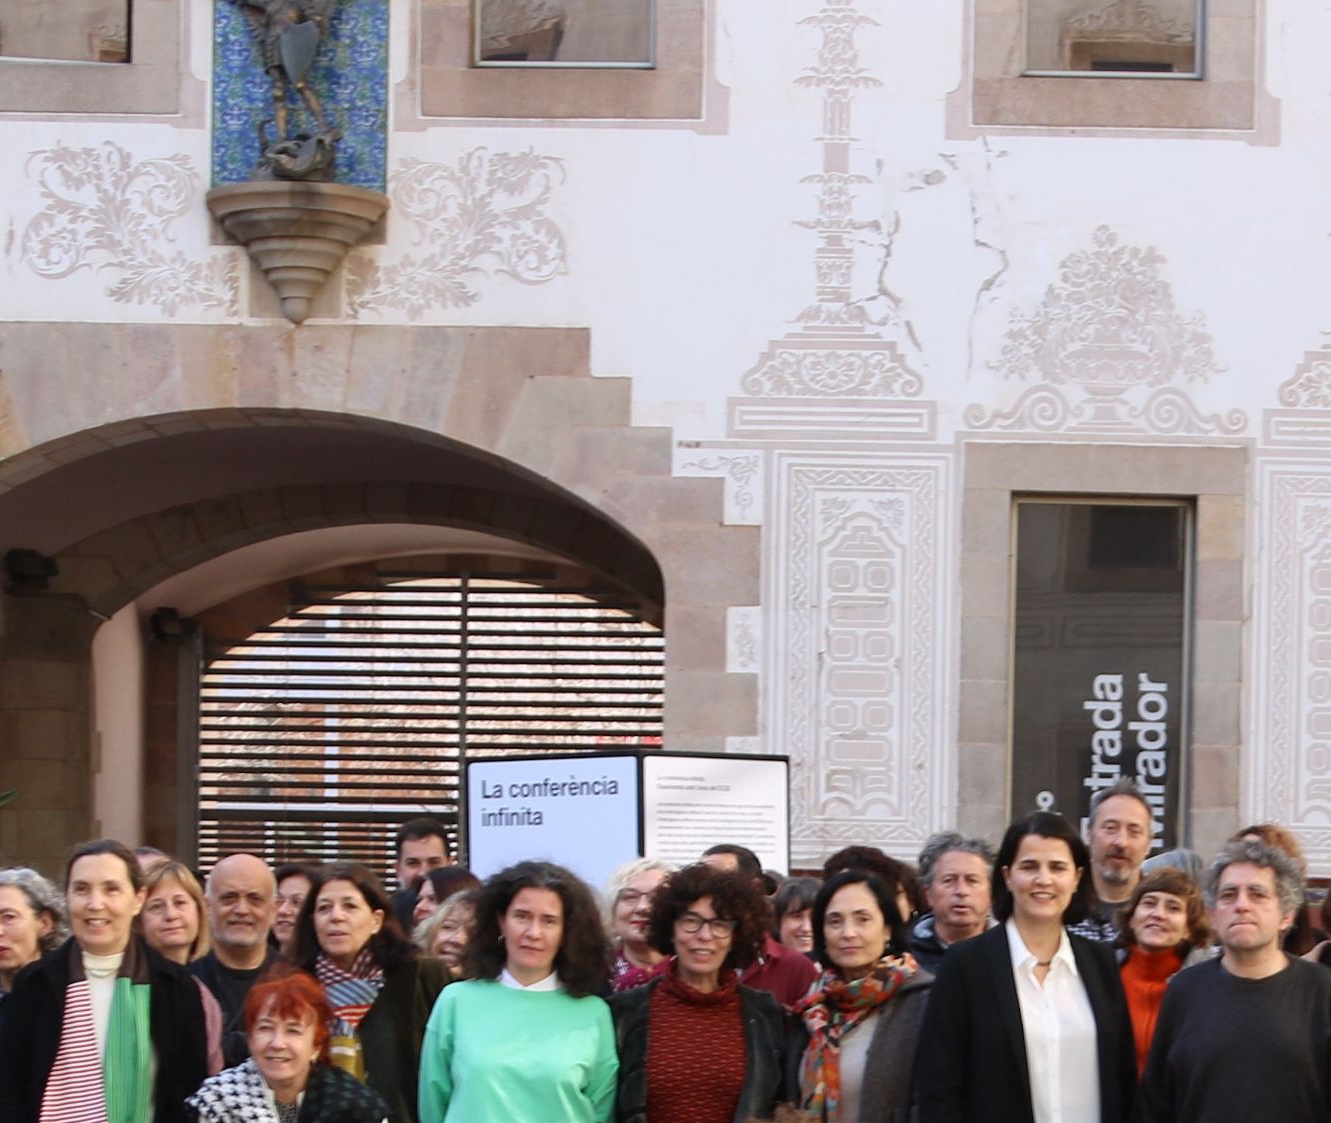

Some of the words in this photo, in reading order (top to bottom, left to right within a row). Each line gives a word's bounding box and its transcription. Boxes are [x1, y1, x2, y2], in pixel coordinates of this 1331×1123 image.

[481, 779, 504, 799] La
[508, 775, 619, 798] conferència
[481, 807, 543, 827] infinita
